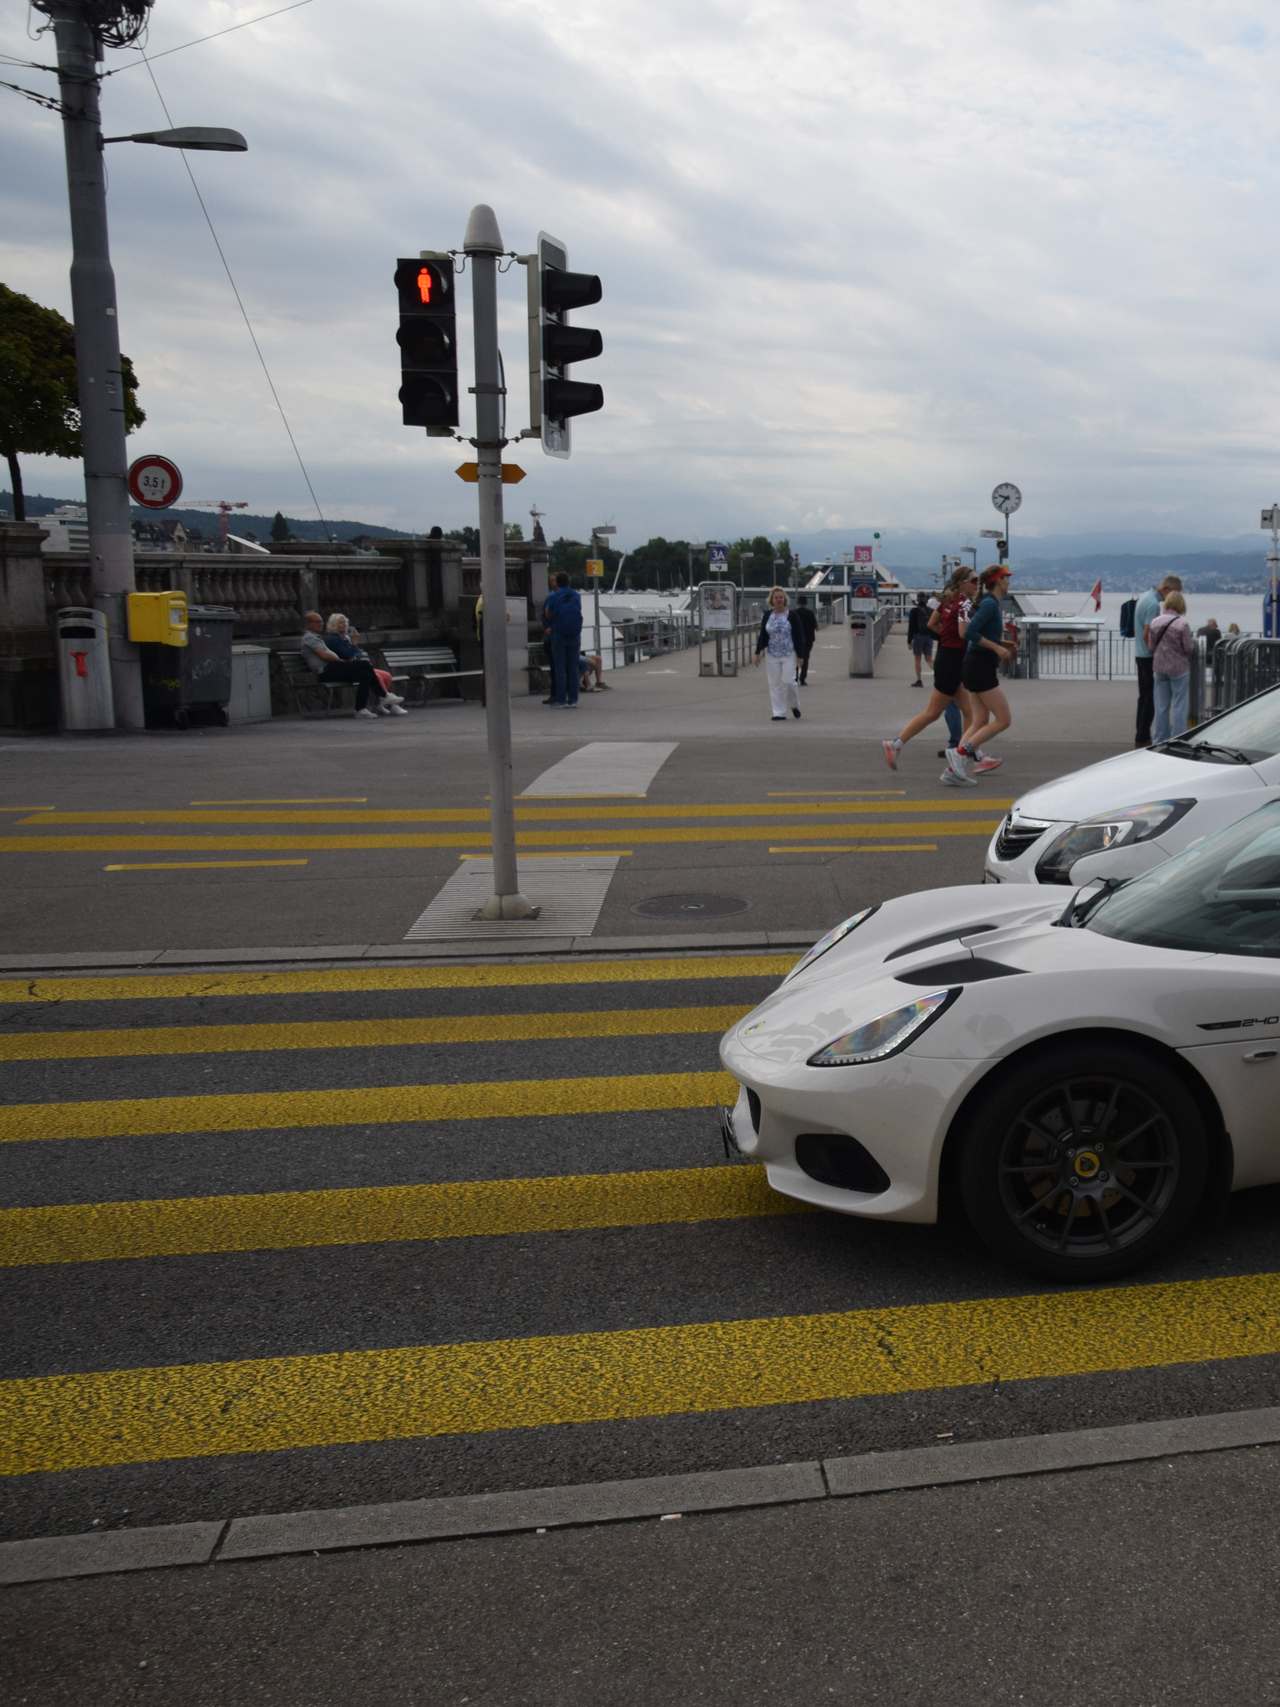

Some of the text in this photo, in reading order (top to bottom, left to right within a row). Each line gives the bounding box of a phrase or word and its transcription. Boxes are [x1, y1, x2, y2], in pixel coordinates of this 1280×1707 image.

[143, 475, 159, 488] 3.5
[712, 550, 725, 561] 3A
[857, 550, 870, 561] 3B
[592, 564, 598, 574] 2
[1242, 1015, 1280, 1028] 240
